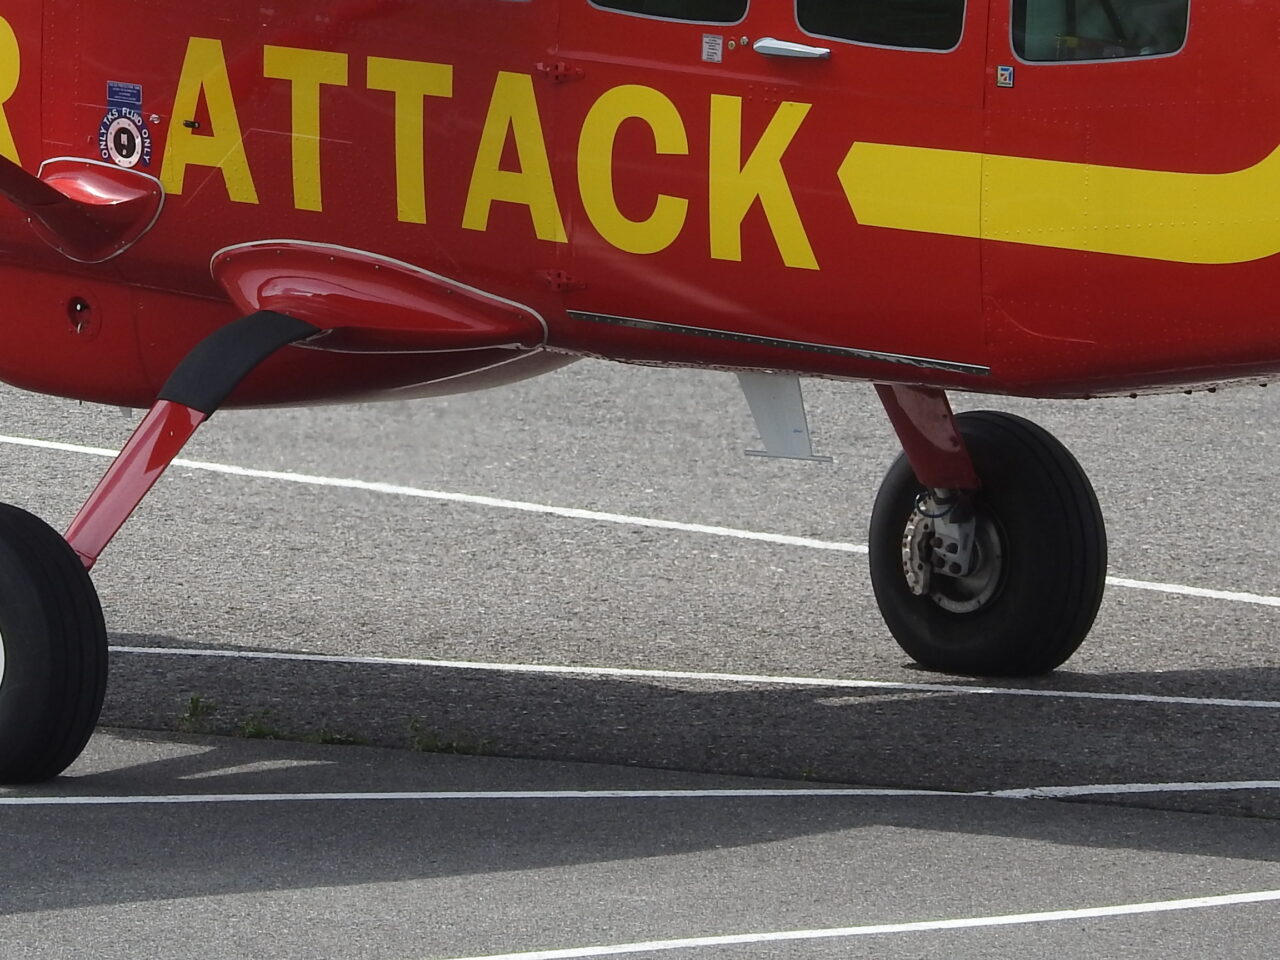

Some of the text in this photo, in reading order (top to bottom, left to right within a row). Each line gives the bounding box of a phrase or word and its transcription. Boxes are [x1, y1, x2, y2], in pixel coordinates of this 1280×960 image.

[99, 107, 151, 163] ONLY TKS FLUID ONLY
[161, 36, 820, 270] ATTACK
